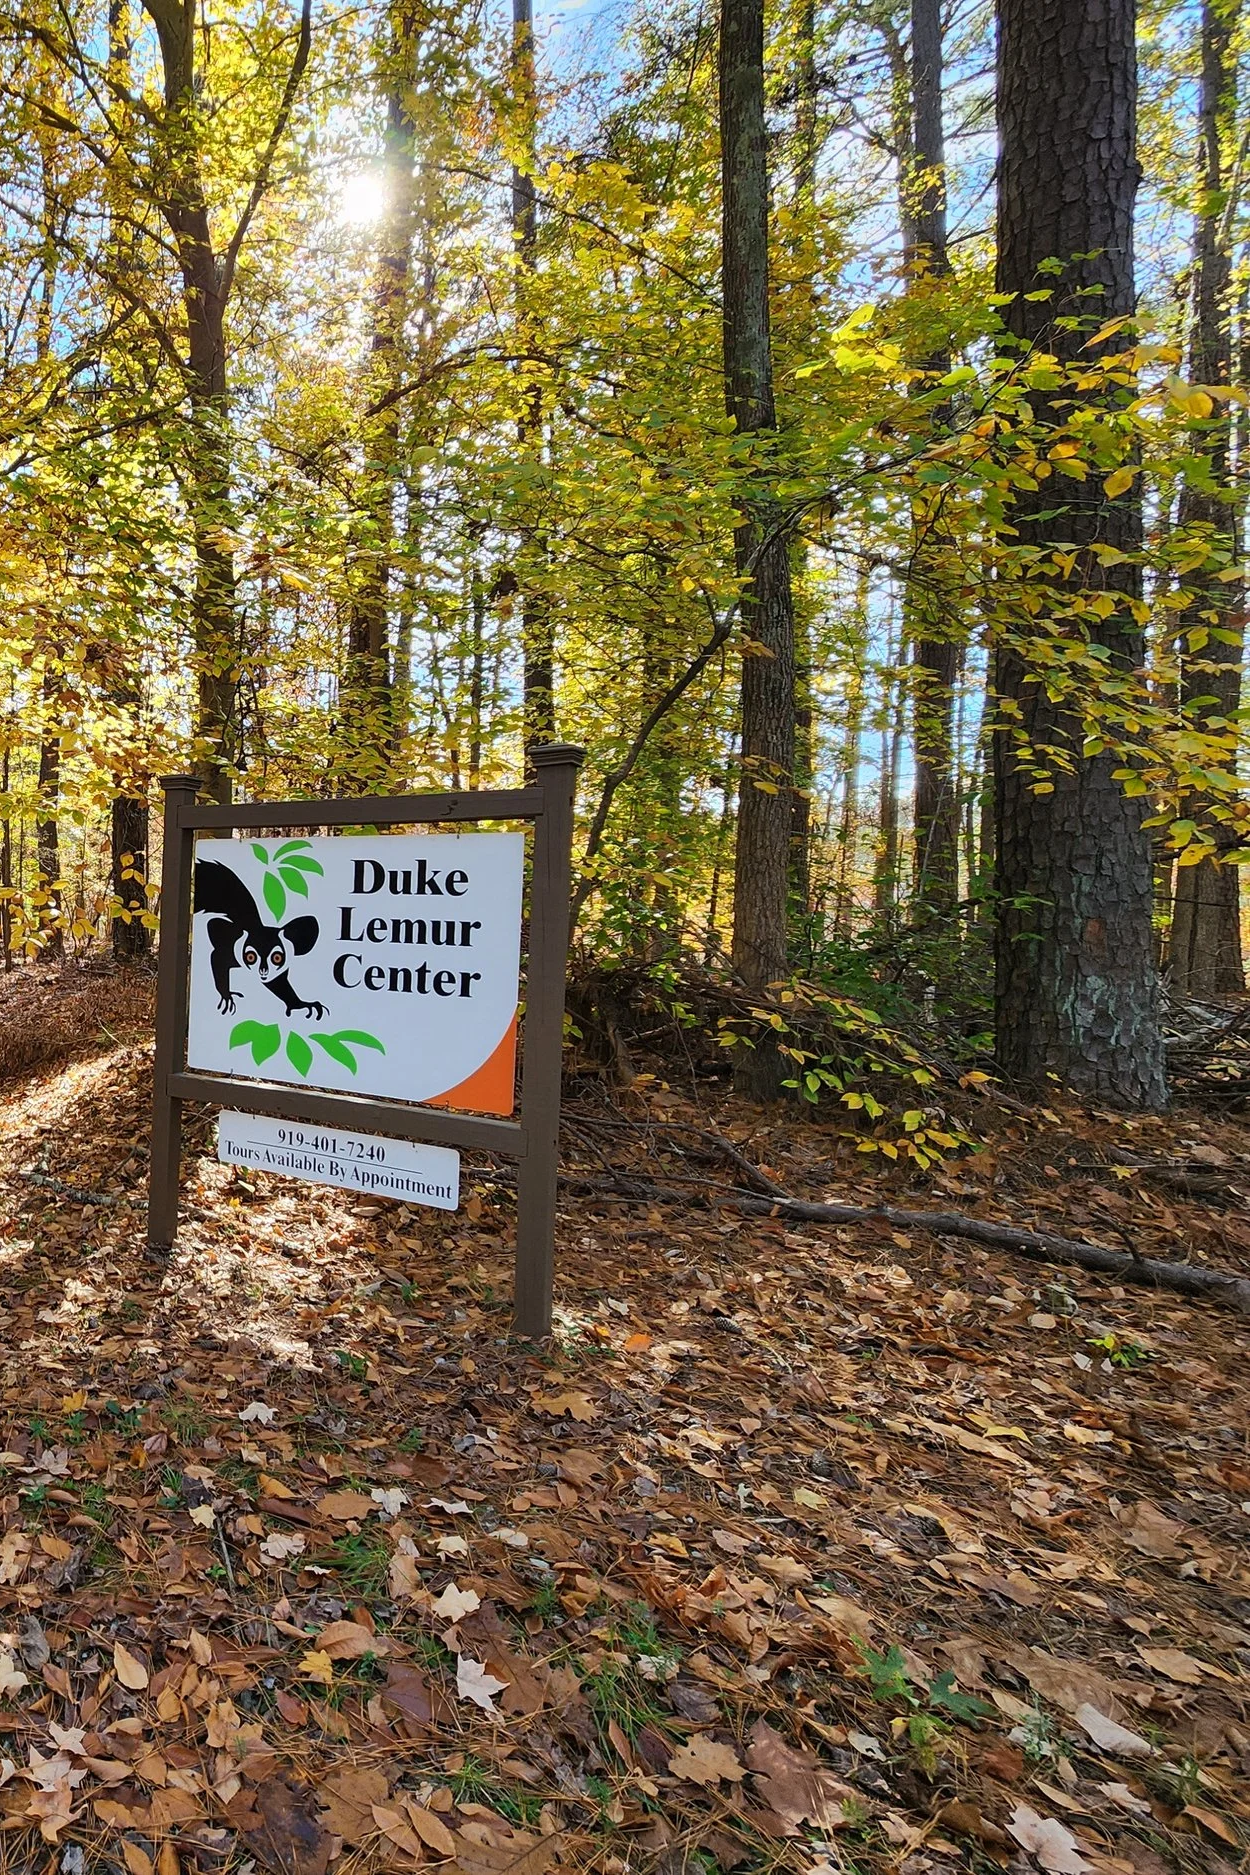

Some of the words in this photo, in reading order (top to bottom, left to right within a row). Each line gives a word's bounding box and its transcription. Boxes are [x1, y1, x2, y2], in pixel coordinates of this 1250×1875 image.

[349, 859, 469, 897] Duke
[335, 906, 482, 947] Lemur
[332, 953, 482, 998] Center
[278, 1128, 385, 1163] 919-401-7240
[225, 1140, 260, 1161] Tours
[263, 1148, 325, 1174] Available
[329, 1160, 347, 1182] By
[350, 1165, 452, 1200] Appointment
